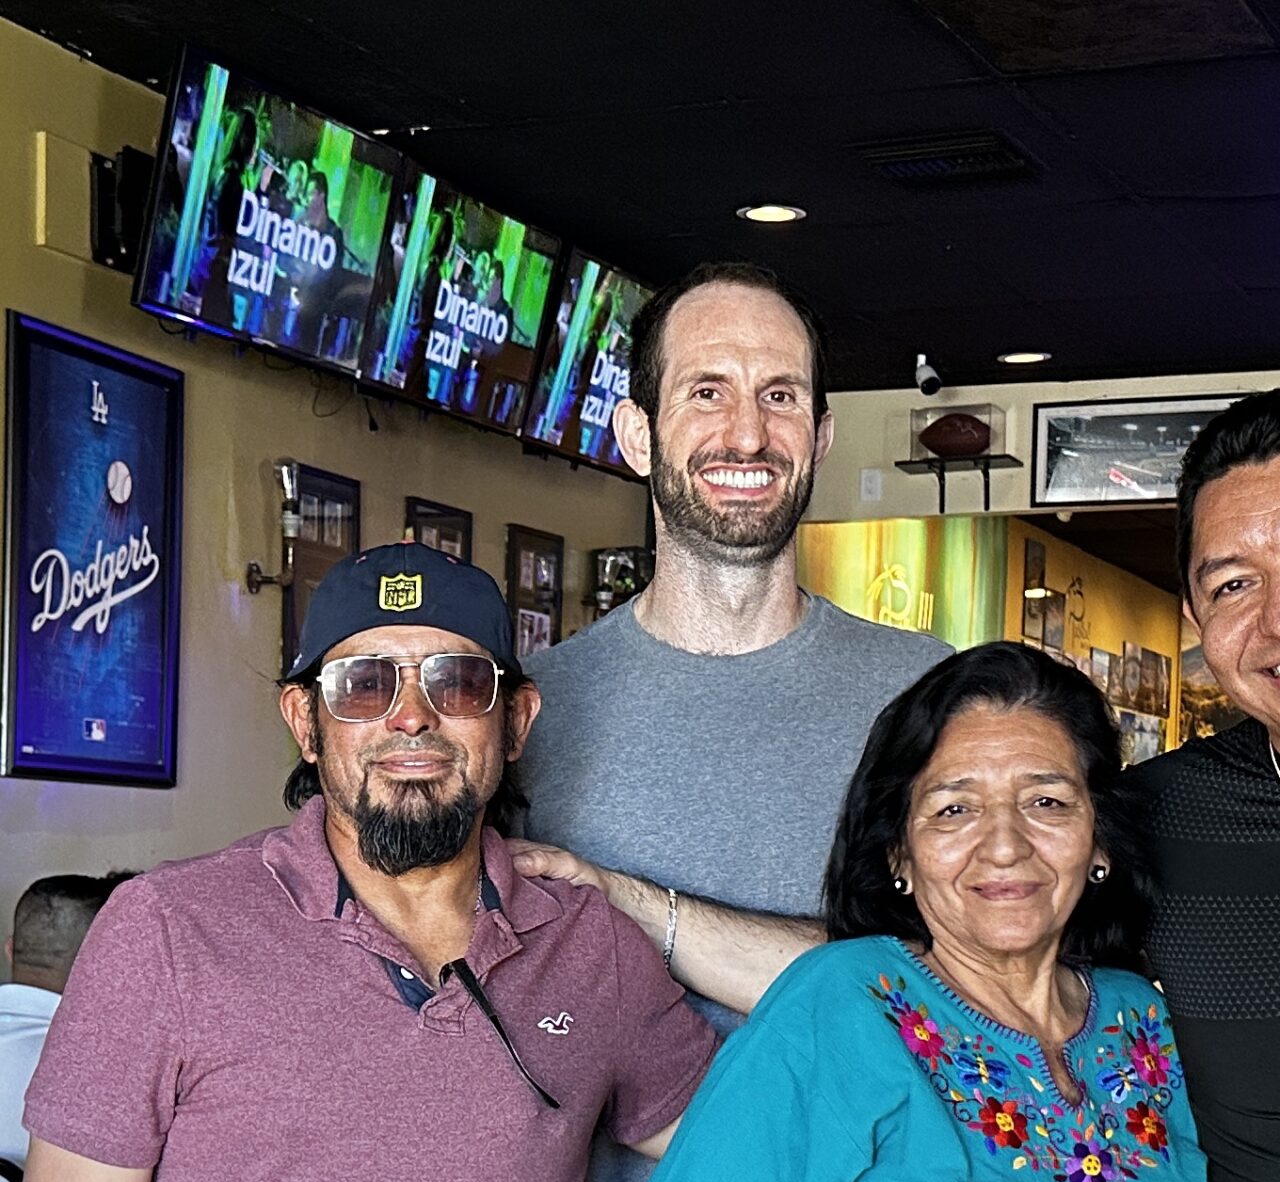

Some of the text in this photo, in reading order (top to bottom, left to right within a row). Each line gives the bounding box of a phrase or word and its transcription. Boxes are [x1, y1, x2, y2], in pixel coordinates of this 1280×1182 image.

[236, 188, 337, 270] Dinamo
[433, 279, 509, 345] Dinamo
[91, 380, 108, 425] LA
[589, 350, 630, 398] Dina
[30, 524, 160, 634] Dodgers
